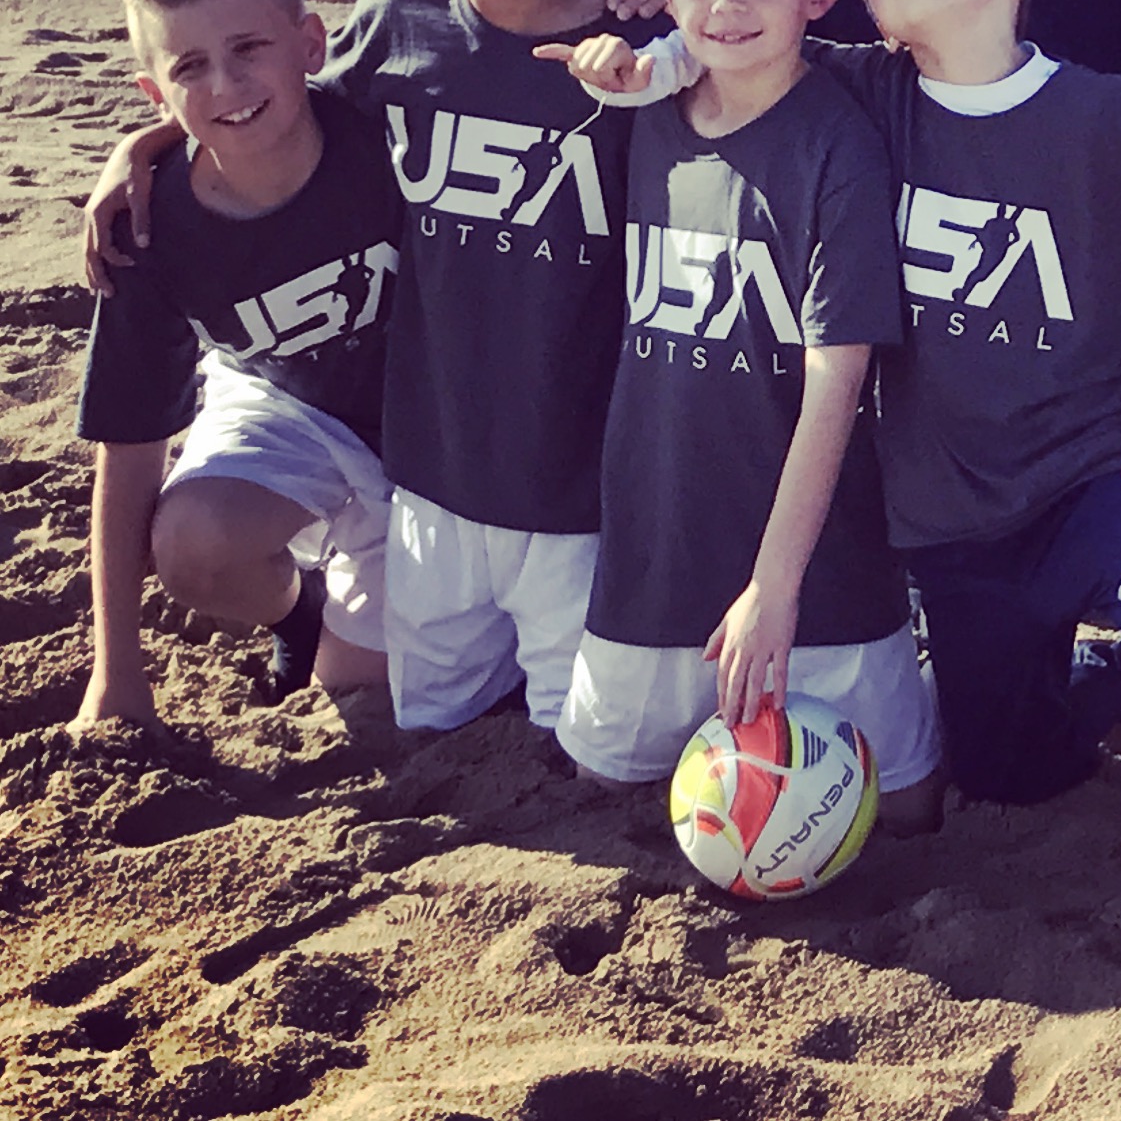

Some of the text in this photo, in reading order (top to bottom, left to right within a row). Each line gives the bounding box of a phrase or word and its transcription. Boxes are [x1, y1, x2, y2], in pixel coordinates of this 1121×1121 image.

[386, 104, 610, 236] USA
[420, 215, 592, 266] UTSAL
[625, 223, 803, 345] USA
[895, 181, 1074, 322] SA
[910, 303, 1053, 352] TSAL
[755, 760, 856, 879] PENALTY
